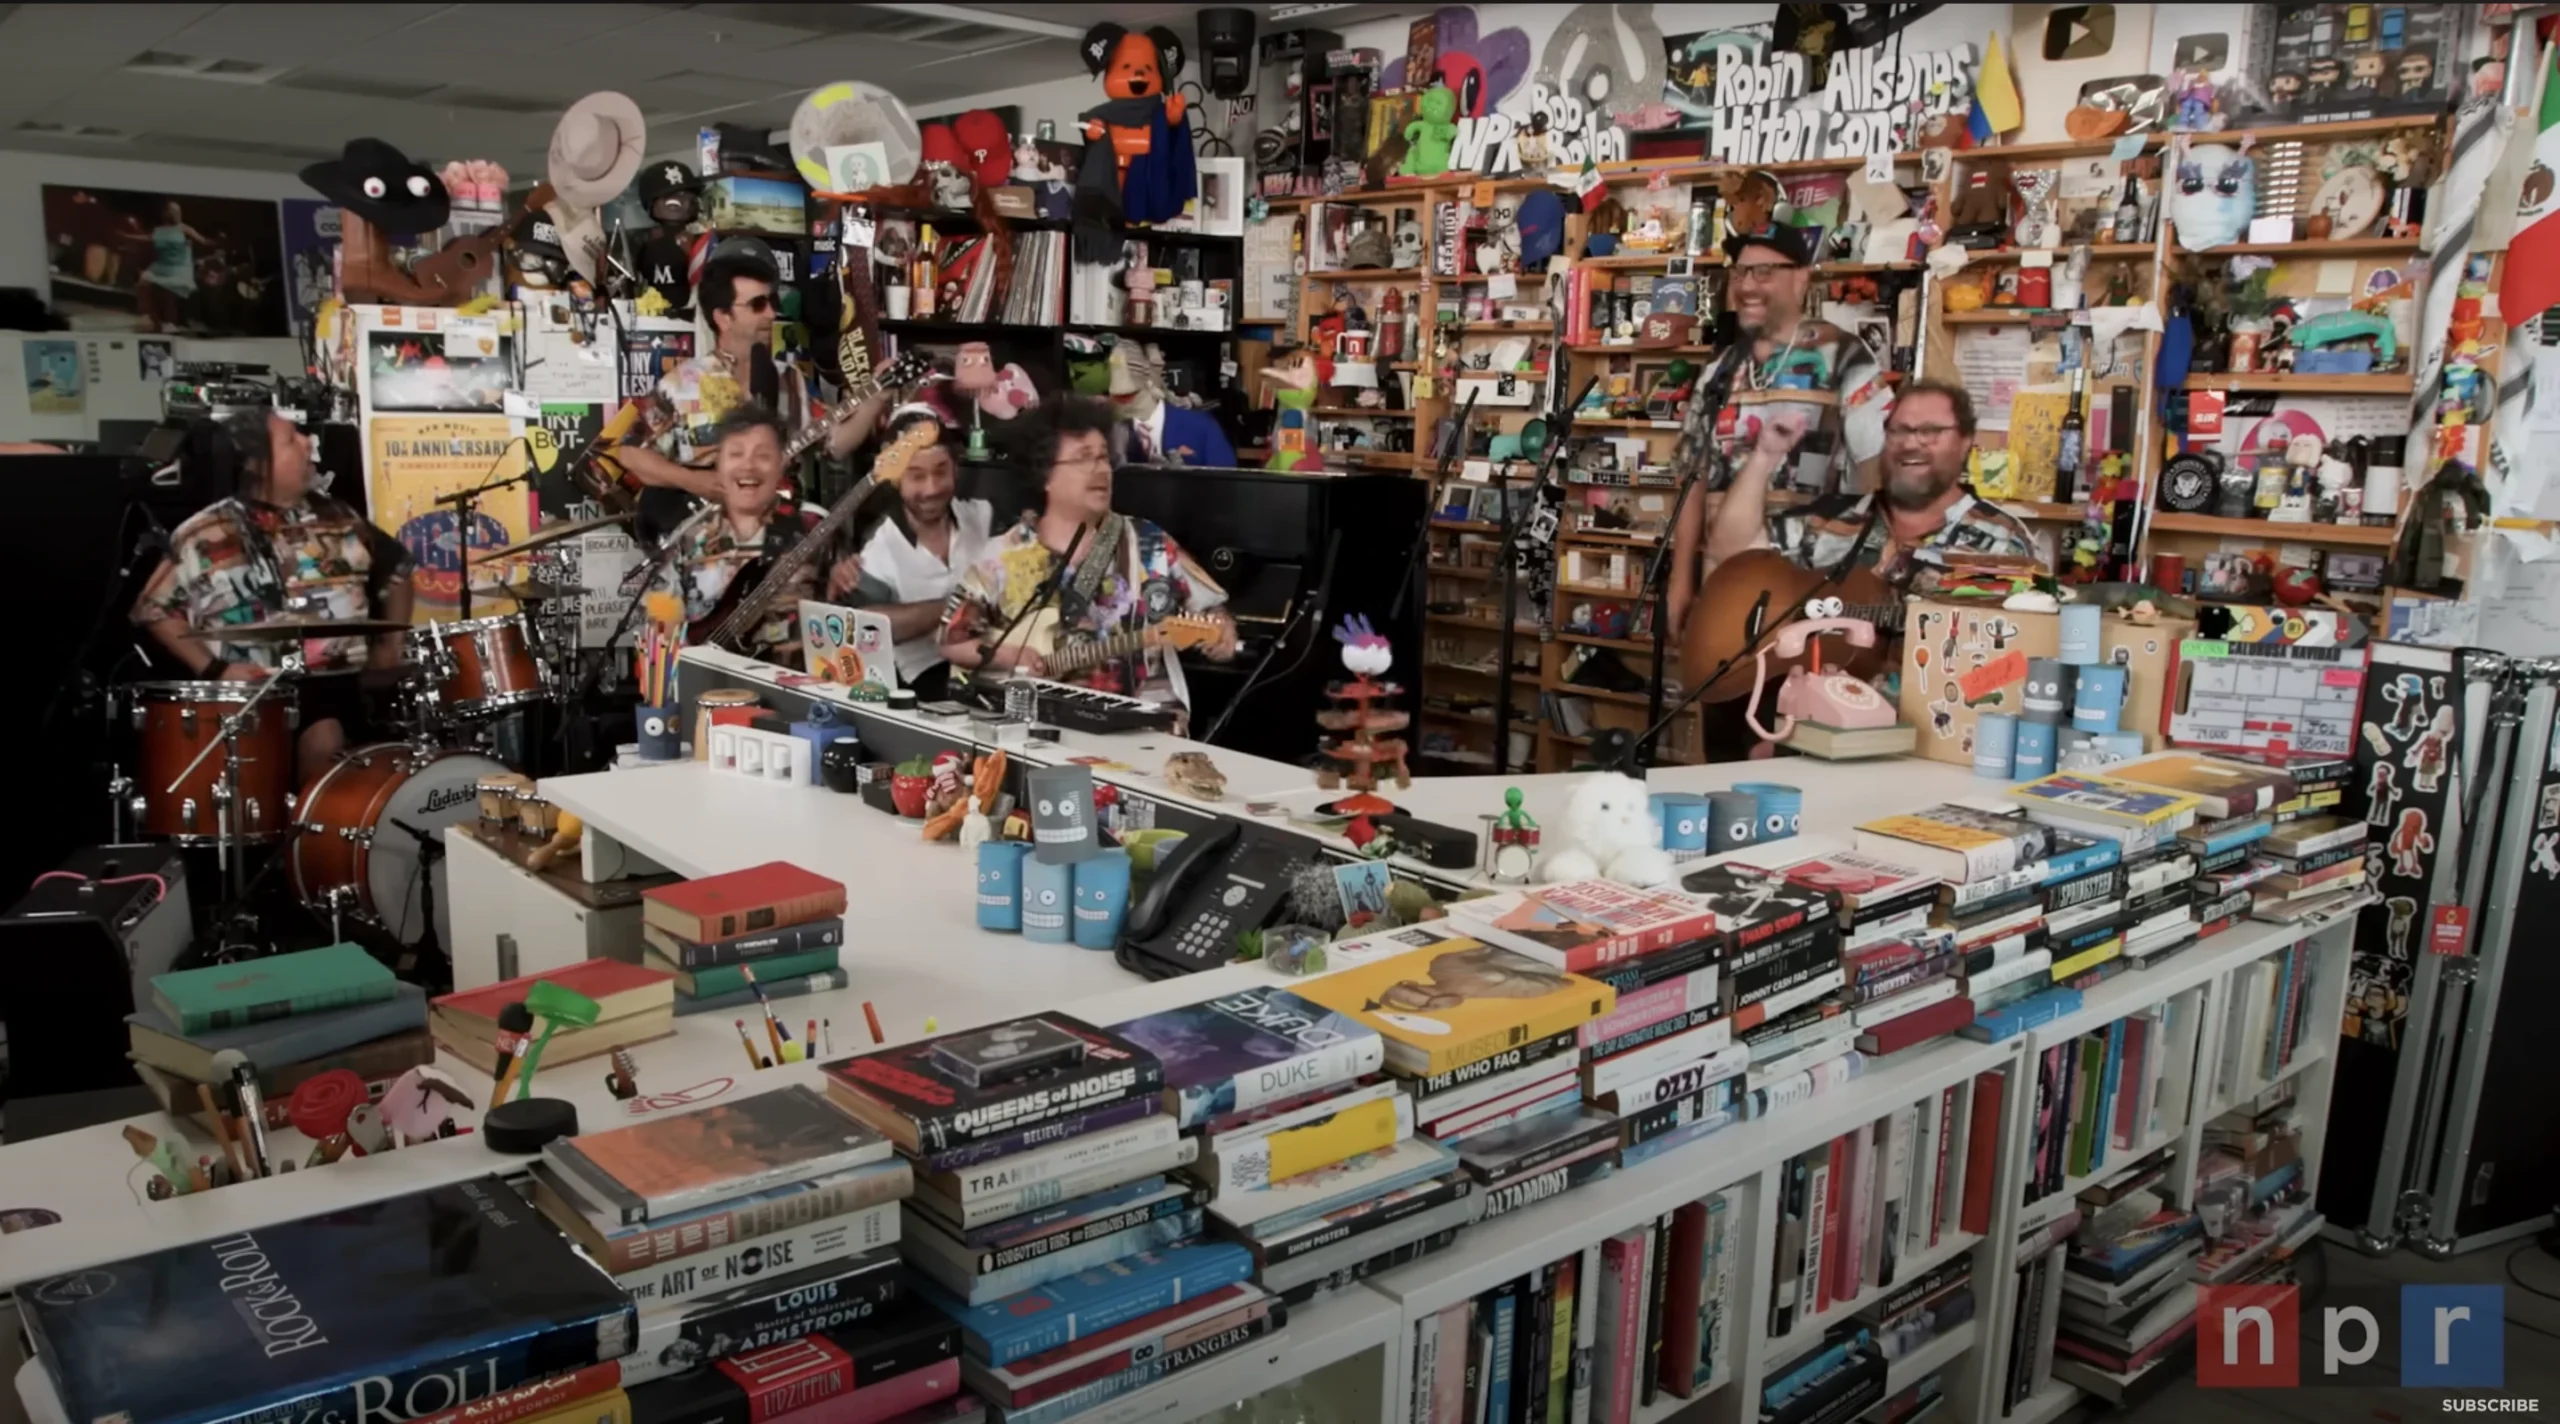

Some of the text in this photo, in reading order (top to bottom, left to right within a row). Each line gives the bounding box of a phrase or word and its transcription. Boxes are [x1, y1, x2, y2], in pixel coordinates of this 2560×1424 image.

[1714, 42, 1804, 108] Robin
[1823, 43, 1973, 116] Allsongs
[1533, 80, 1583, 132] Bob
[1448, 113, 1532, 173] NPR
[1550, 109, 1627, 166] Boilen
[1711, 101, 1822, 164] Hilton
[653, 265, 676, 285] M
[846, 326, 871, 375] BLACK
[1350, 340, 1360, 352] n
[444, 423, 478, 435] MUSIC
[535, 431, 585, 450] BUT-
[538, 415, 583, 430] TINY
[412, 439, 510, 457] ANNIVERSARY
[714, 731, 793, 778] npr
[417, 783, 477, 814] Ludwig
[2085, 850, 2113, 869] DYLAN
[1563, 881, 1627, 903] MUSIC
[2059, 870, 2114, 909] SPRINGSTEEN
[1739, 969, 1809, 1007] JOHNNY CASH FAQ
[1213, 992, 1346, 1048] DUKE
[1260, 1058, 1321, 1093] DUKE
[1427, 1050, 1521, 1093] THE WHO FAQ
[1654, 1065, 1706, 1103] OZZY
[953, 1090, 1050, 1134] QUEENS
[1051, 1087, 1069, 1104] of
[1069, 1066, 1137, 1099] NOISE
[1022, 1122, 1065, 1145] BELIEVE
[1015, 1179, 1063, 1213] JACO
[1485, 1167, 1569, 1219] ALTAMONT
[996, 1236, 1049, 1268] FORGOTTEN
[1288, 1225, 1350, 1256] SHOW POSTERS
[210, 1232, 281, 1293] ROLL
[628, 1239, 795, 1301] THE ART OF NOISE
[774, 1281, 839, 1313] LOUIS
[1804, 1270, 1818, 1301] There
[1888, 1276, 1942, 1311] NIRVANA FAQ
[246, 1284, 330, 1358] ROCK
[739, 1302, 874, 1353] ARMSTRONG
[753, 1295, 866, 1332] Master of Modernism
[1153, 1323, 1251, 1375] STRANGERS
[353, 1356, 513, 1424] ROLL
